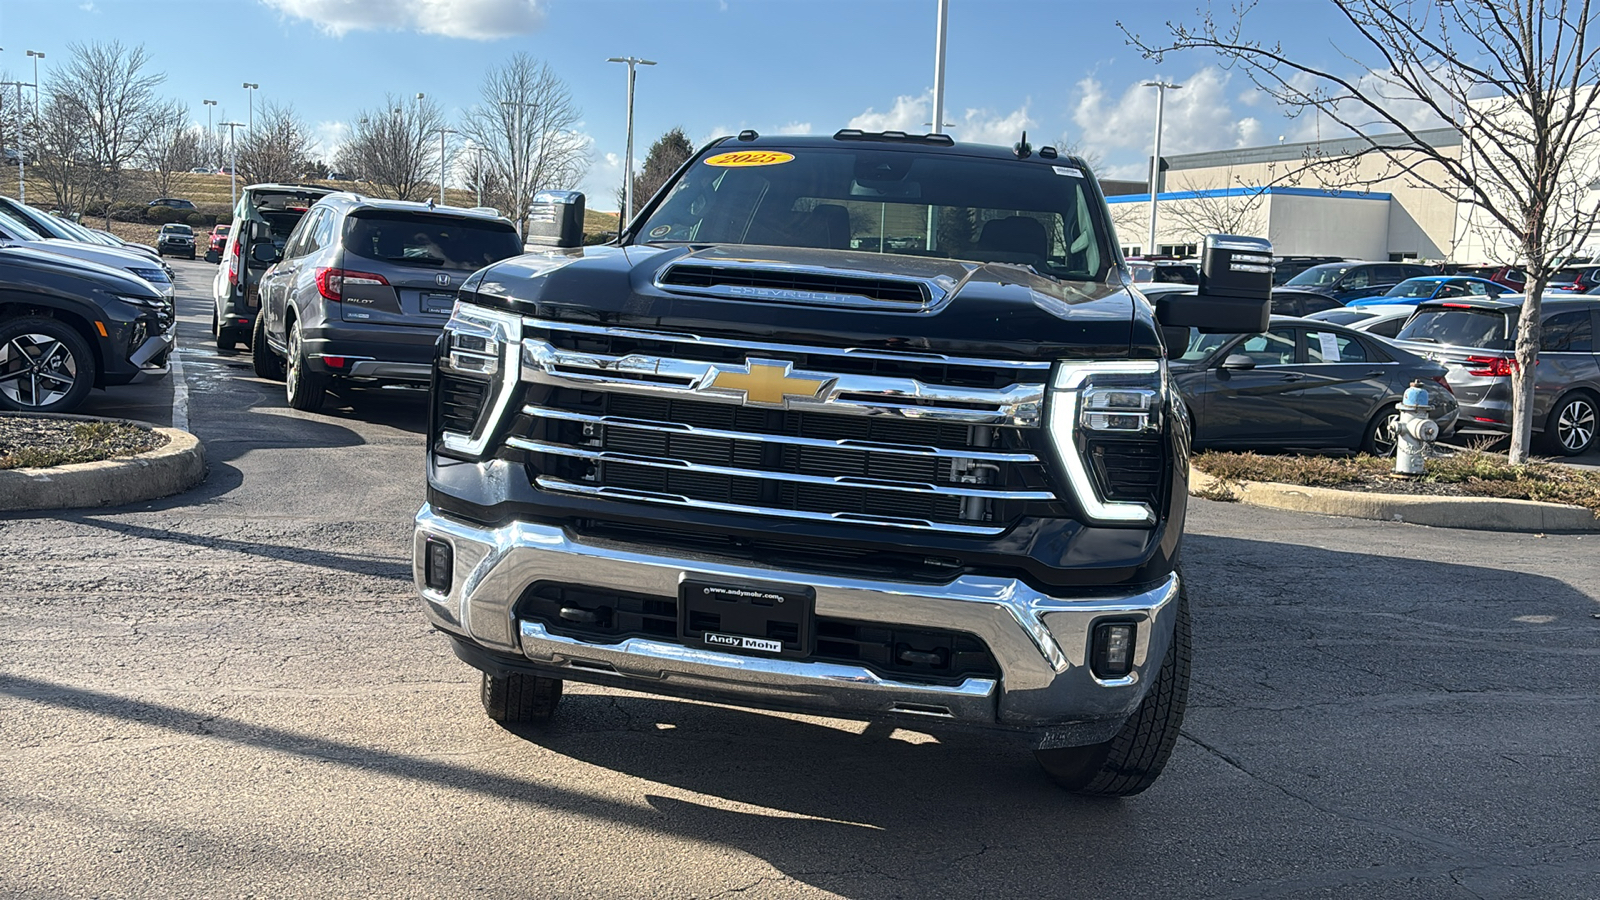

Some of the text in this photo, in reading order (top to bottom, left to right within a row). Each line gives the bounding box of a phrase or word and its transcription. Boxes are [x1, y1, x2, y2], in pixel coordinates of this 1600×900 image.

[717, 154, 783, 164] 2025
[729, 286, 851, 301] CHEVROLET
[709, 587, 780, 600] www.andymohr.com
[709, 635, 779, 650] Andy Mohr
